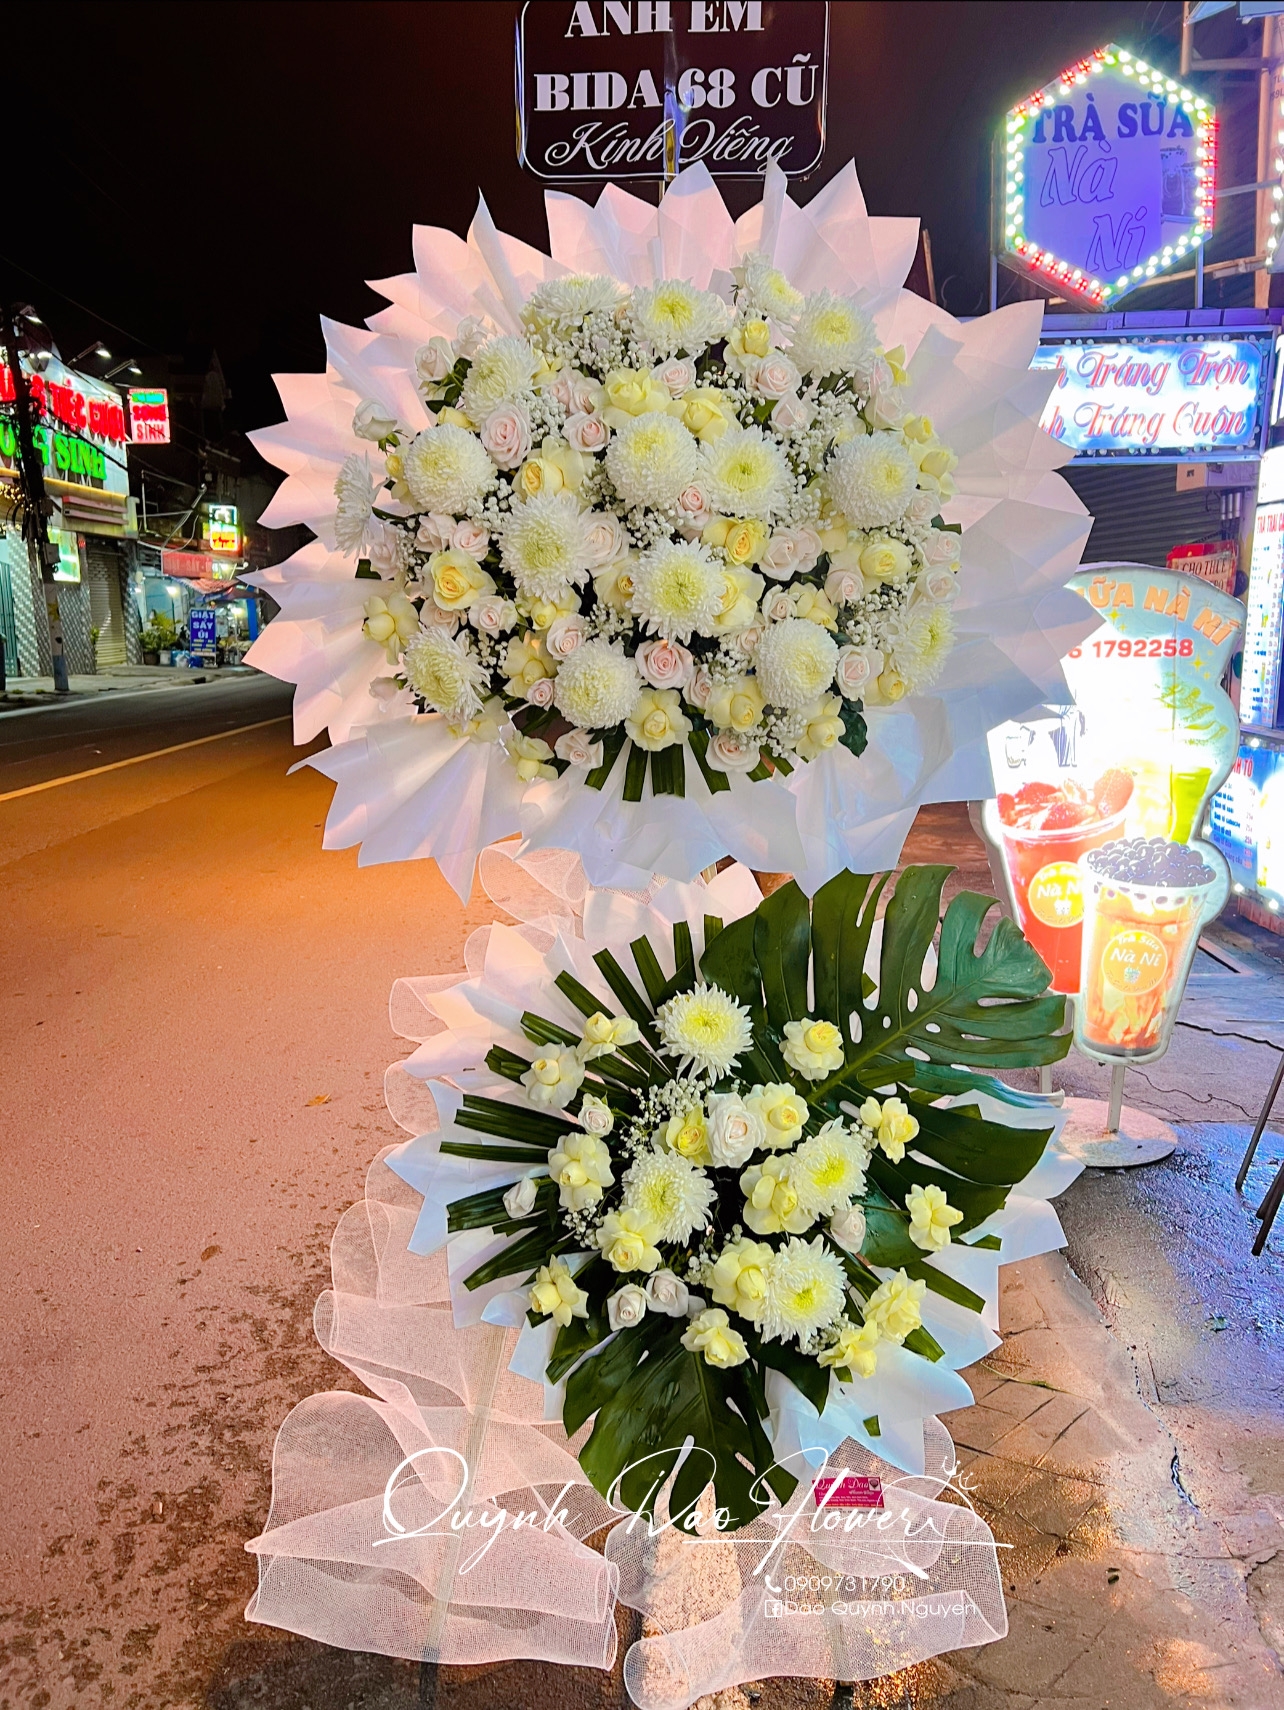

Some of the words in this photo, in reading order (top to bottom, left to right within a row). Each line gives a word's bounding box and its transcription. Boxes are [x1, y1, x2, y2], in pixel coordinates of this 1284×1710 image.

[564, 1, 673, 37] ANH
[688, 1, 764, 32] EM
[534, 69, 663, 111] BIDA
[678, 67, 736, 109] 68
[751, 52, 819, 108] CŨ
[1032, 92, 1106, 144] TRÀ
[545, 119, 675, 170] Kính
[679, 115, 795, 173] Viếng
[1040, 142, 1118, 208] Nà
[1076, 350, 1171, 395] Tráng
[1178, 348, 1250, 390] Trộn
[54, 431, 107, 481] SINH
[1075, 576, 1134, 608] ỮA
[1092, 638, 1194, 658] 1792258
